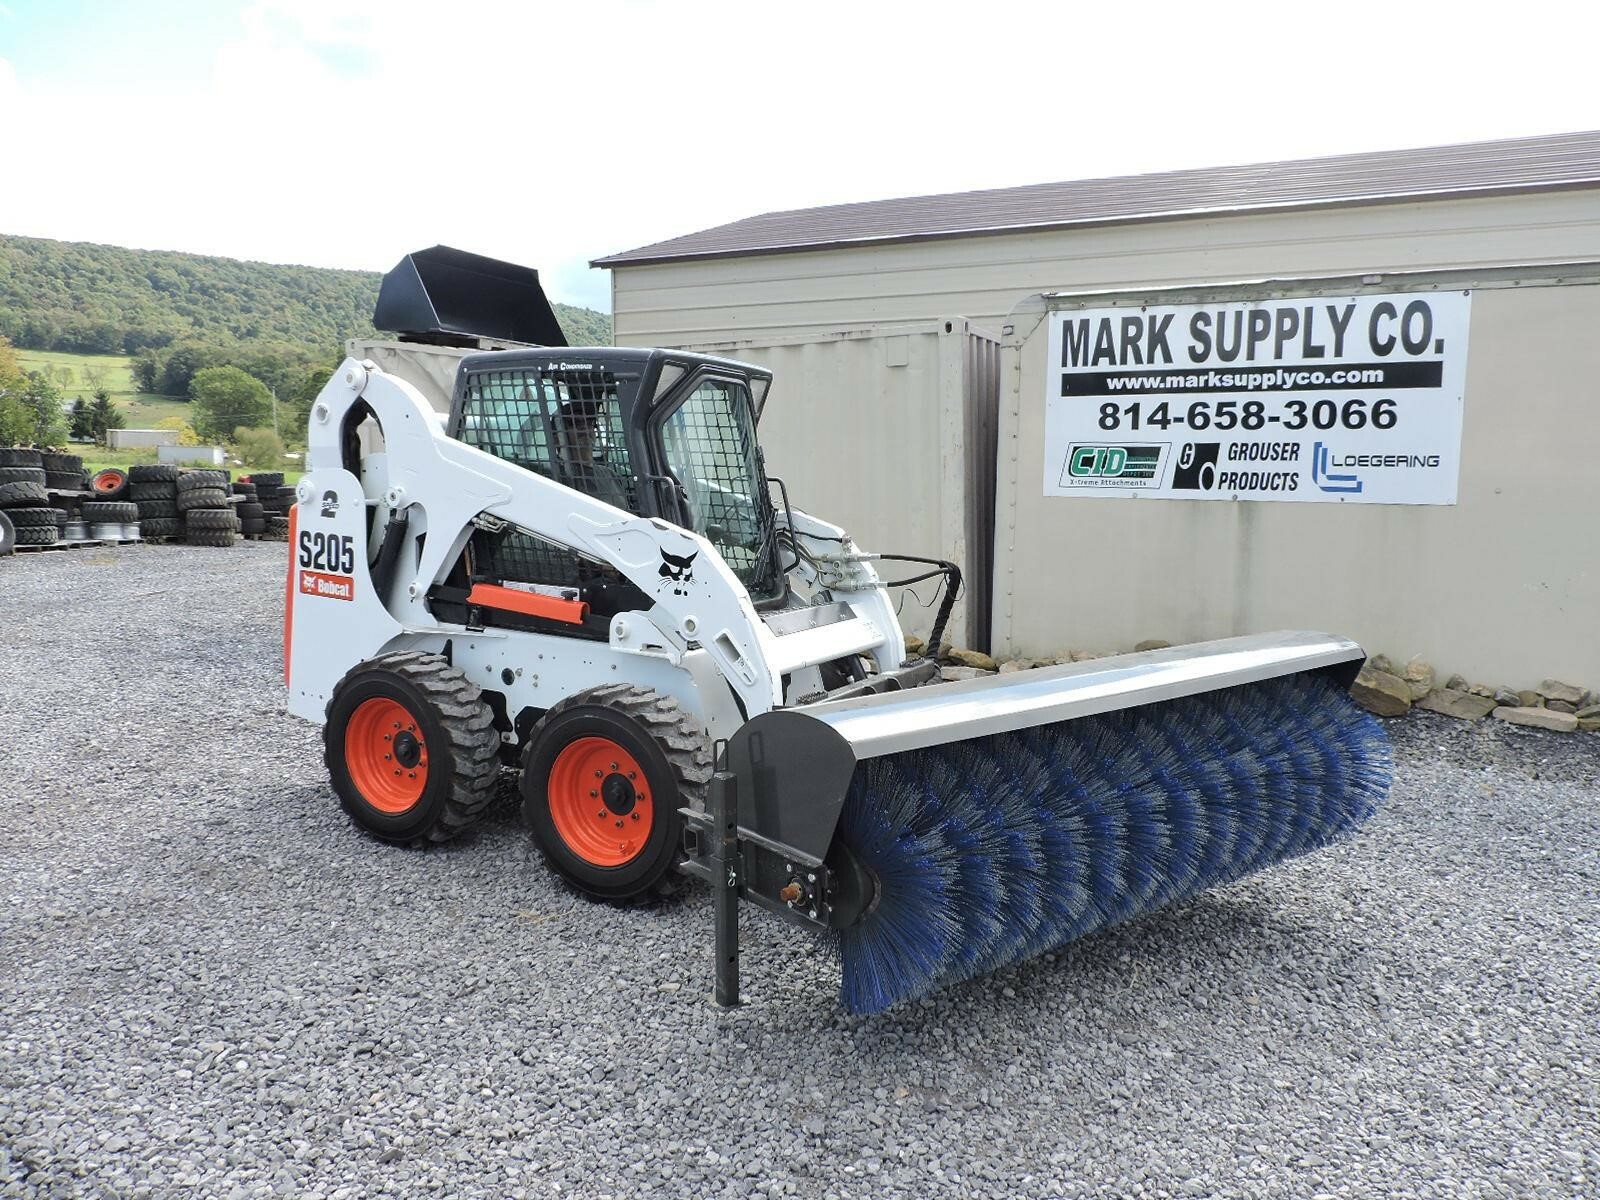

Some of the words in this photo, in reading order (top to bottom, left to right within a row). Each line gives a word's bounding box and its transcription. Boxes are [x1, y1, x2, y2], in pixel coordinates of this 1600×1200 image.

[1061, 313, 1175, 368] MARK
[1187, 303, 1357, 364] SUPPLY
[1368, 299, 1444, 358] CO.
[1106, 369, 1384, 390] www.marksupplyco.com
[1098, 398, 1398, 431] 814-658-3066
[1070, 447, 1128, 477] CID
[1227, 442, 1301, 462] GROUSER
[1331, 454, 1440, 468] LOEGERING
[1100, 478, 1147, 487] Attachments
[1218, 471, 1300, 492] PRODUCTS
[320, 489, 339, 519] 2
[299, 530, 354, 575] S205
[317, 578, 351, 597] Bobcat
